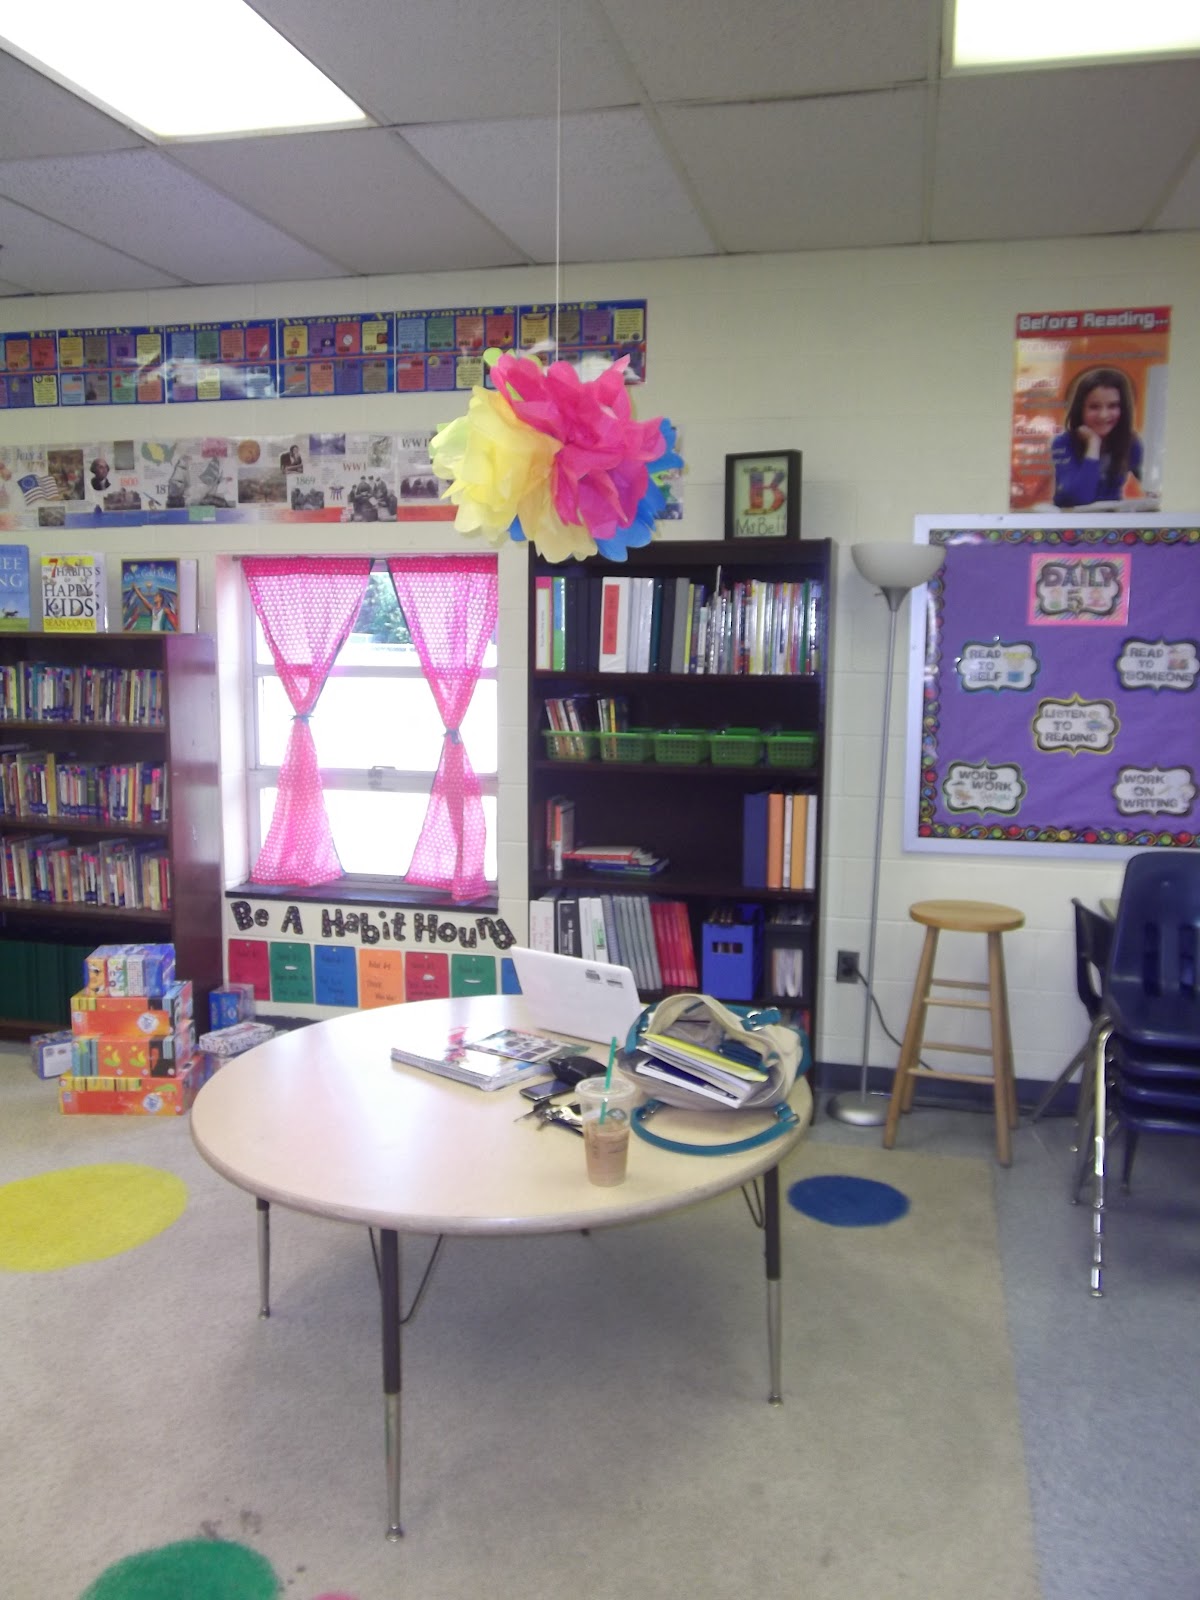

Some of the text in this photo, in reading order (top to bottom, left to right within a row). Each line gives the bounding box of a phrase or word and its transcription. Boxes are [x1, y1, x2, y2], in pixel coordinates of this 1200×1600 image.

[1019, 314, 1078, 331] Before
[0, 556, 24, 571] EE
[49, 558, 59, 578] 7
[57, 566, 93, 577] HABITS
[1043, 567, 1117, 588] DAILY
[44, 583, 94, 597] HAPPY
[1066, 589, 1084, 611] 5
[44, 598, 95, 618] KIDS
[969, 649, 1001, 659] READ
[1130, 647, 1164, 658] READ
[978, 661, 995, 671] TO
[1138, 659, 1155, 669] TO
[969, 672, 1002, 682] SELF
[1125, 671, 1194, 682] SOMEONE
[1044, 709, 1087, 719] LISTEN
[1053, 720, 1073, 731] TO
[1044, 732, 1098, 743] READING
[958, 769, 998, 781] WORD
[1123, 773, 1166, 784] WORK
[971, 780, 1013, 791] WORK
[1134, 786, 1155, 796] ON
[1123, 798, 1179, 809] WRITING
[230, 900, 270, 931] Be
[280, 905, 304, 935] A
[321, 908, 406, 945] Habit
[413, 912, 517, 950] Hound
